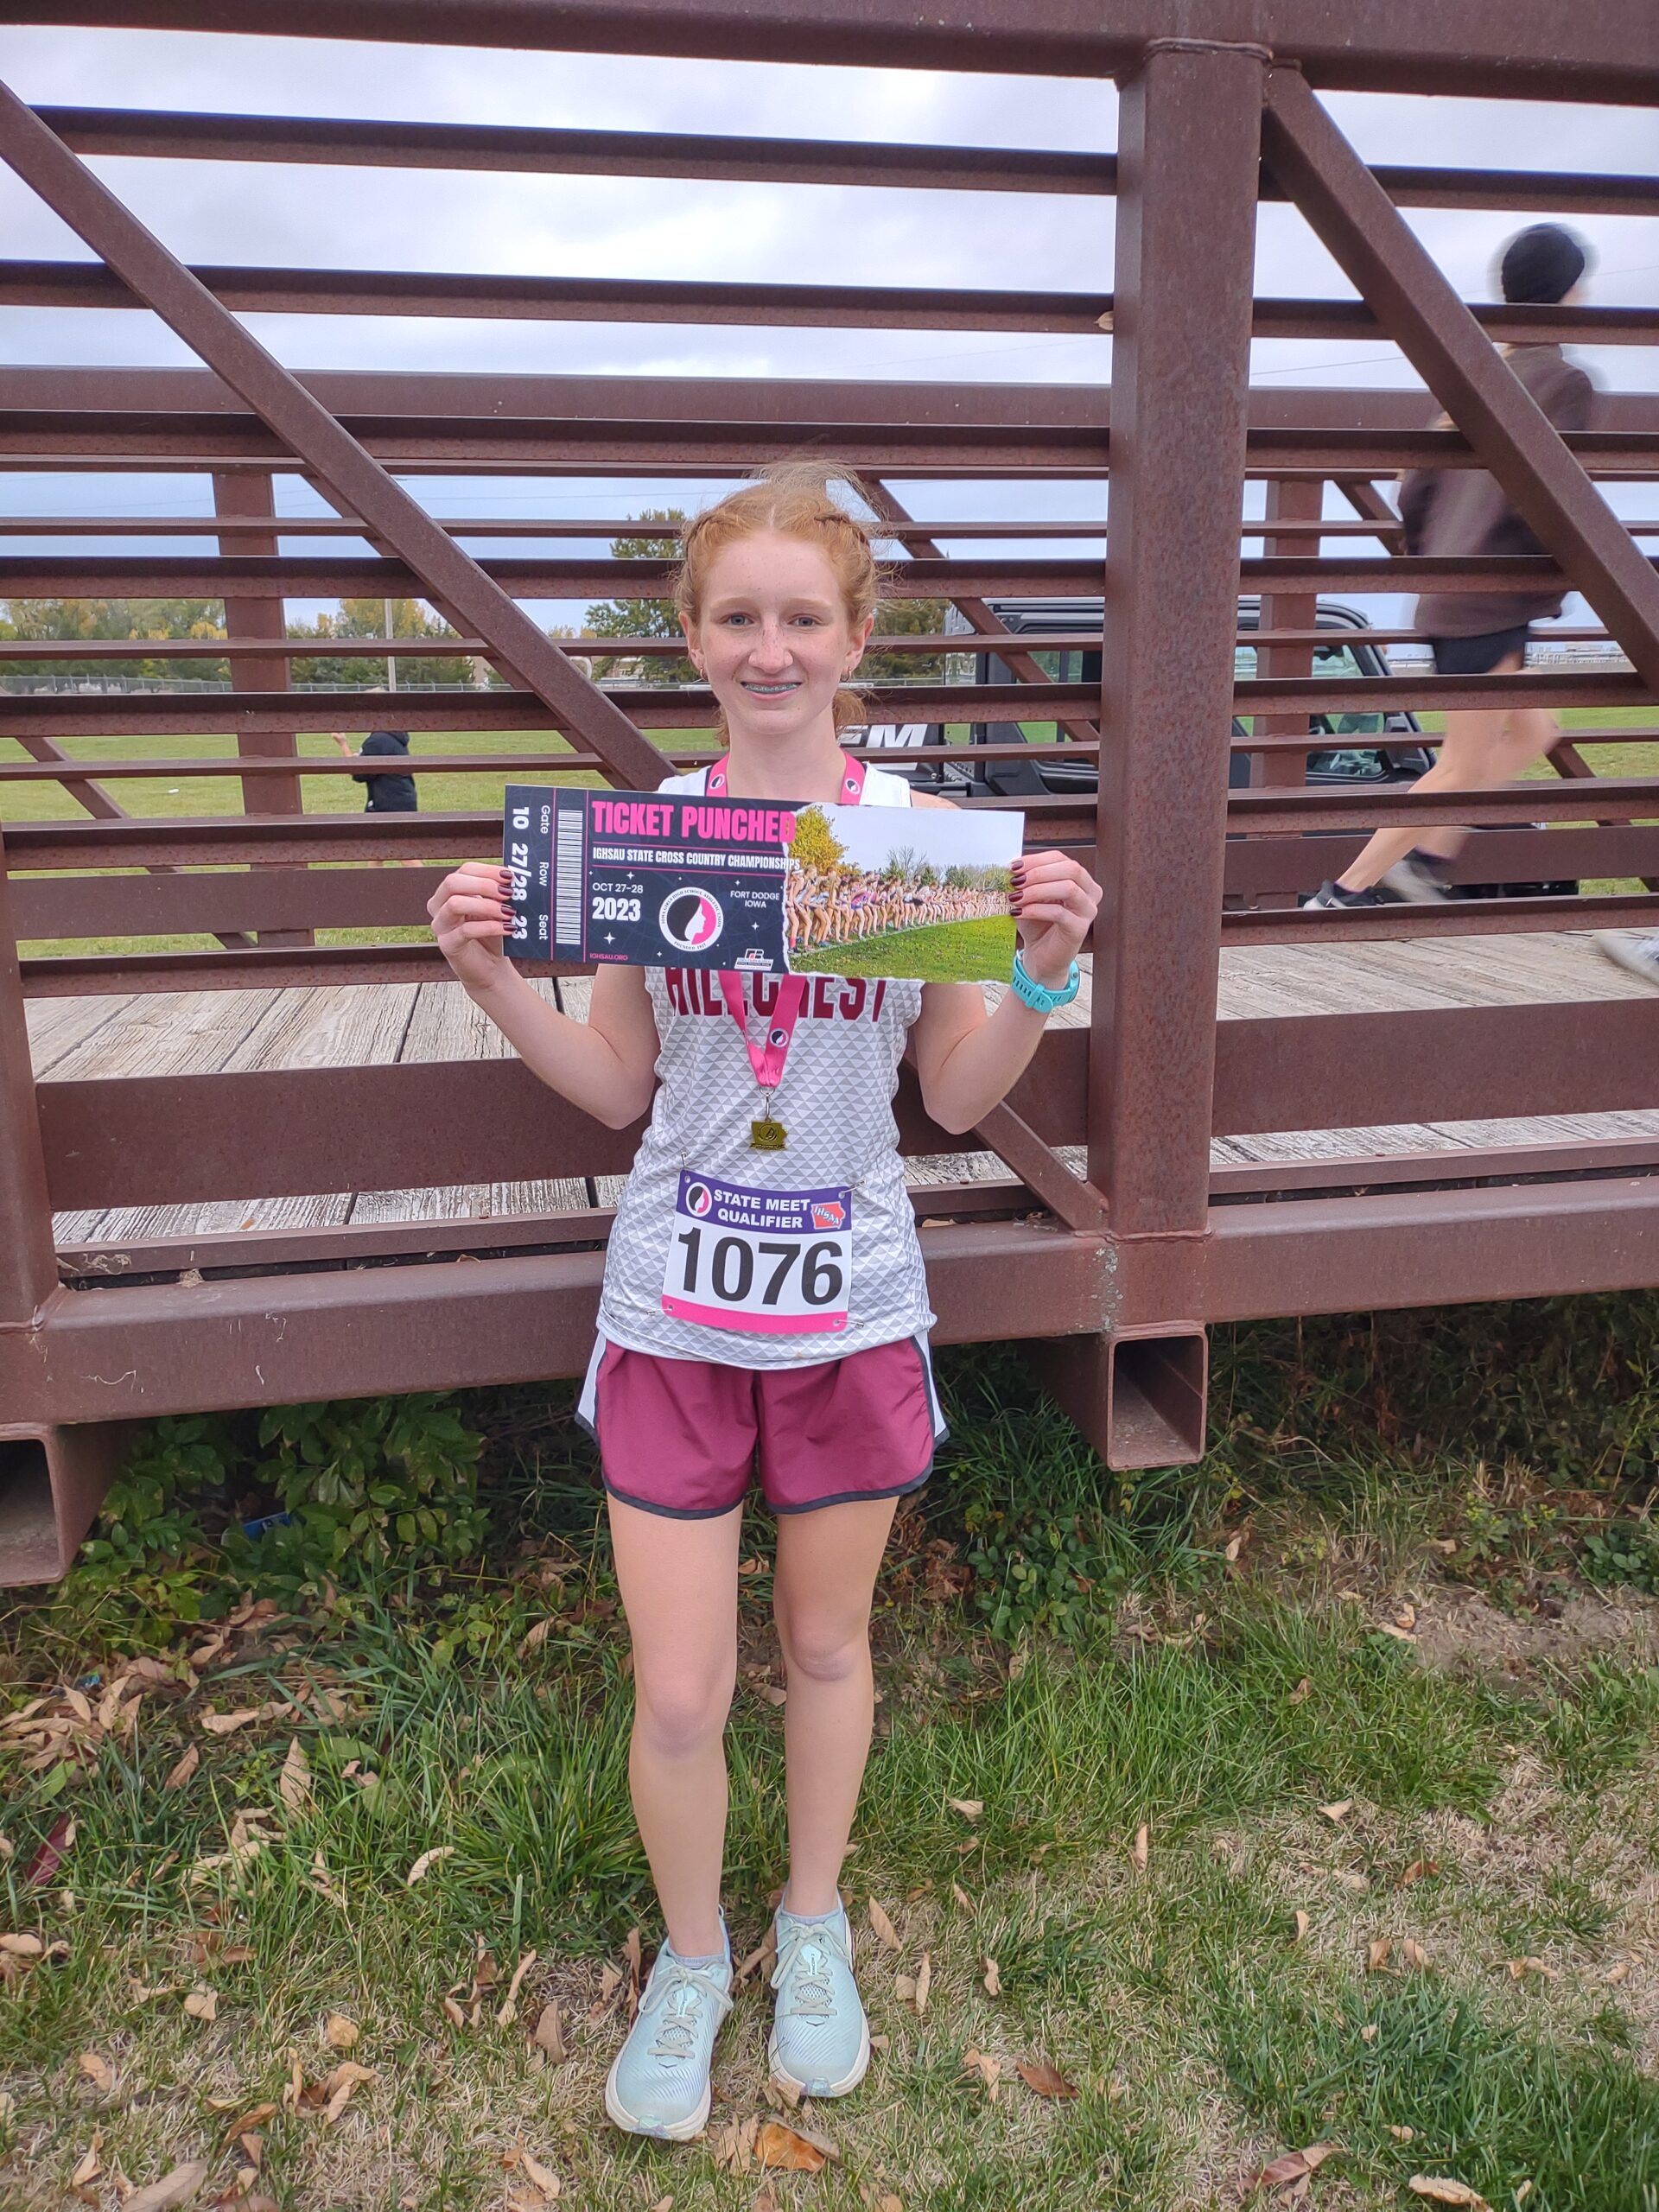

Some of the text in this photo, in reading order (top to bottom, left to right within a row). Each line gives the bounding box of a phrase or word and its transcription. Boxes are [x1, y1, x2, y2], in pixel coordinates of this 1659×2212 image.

[592, 800, 797, 843] TICKET PUNCHED
[592, 847, 800, 871] IGHSAU STATE CROSS COUNTRY CHAMPIONSHIPS
[508, 806, 532, 940] 10 27/28 23
[538, 804, 551, 941] Gate Row Seat
[592, 882, 644, 893] OCT 27-28
[730, 890, 780, 901] FORT DODGE
[592, 896, 641, 922] 2023
[744, 899, 767, 908] IOWA
[589, 952, 629, 962] IGHSAU.ORG
[713, 1188, 810, 1212] STATE MEET
[717, 1208, 803, 1229] QUALIFIER
[678, 1226, 843, 1306] 1076
